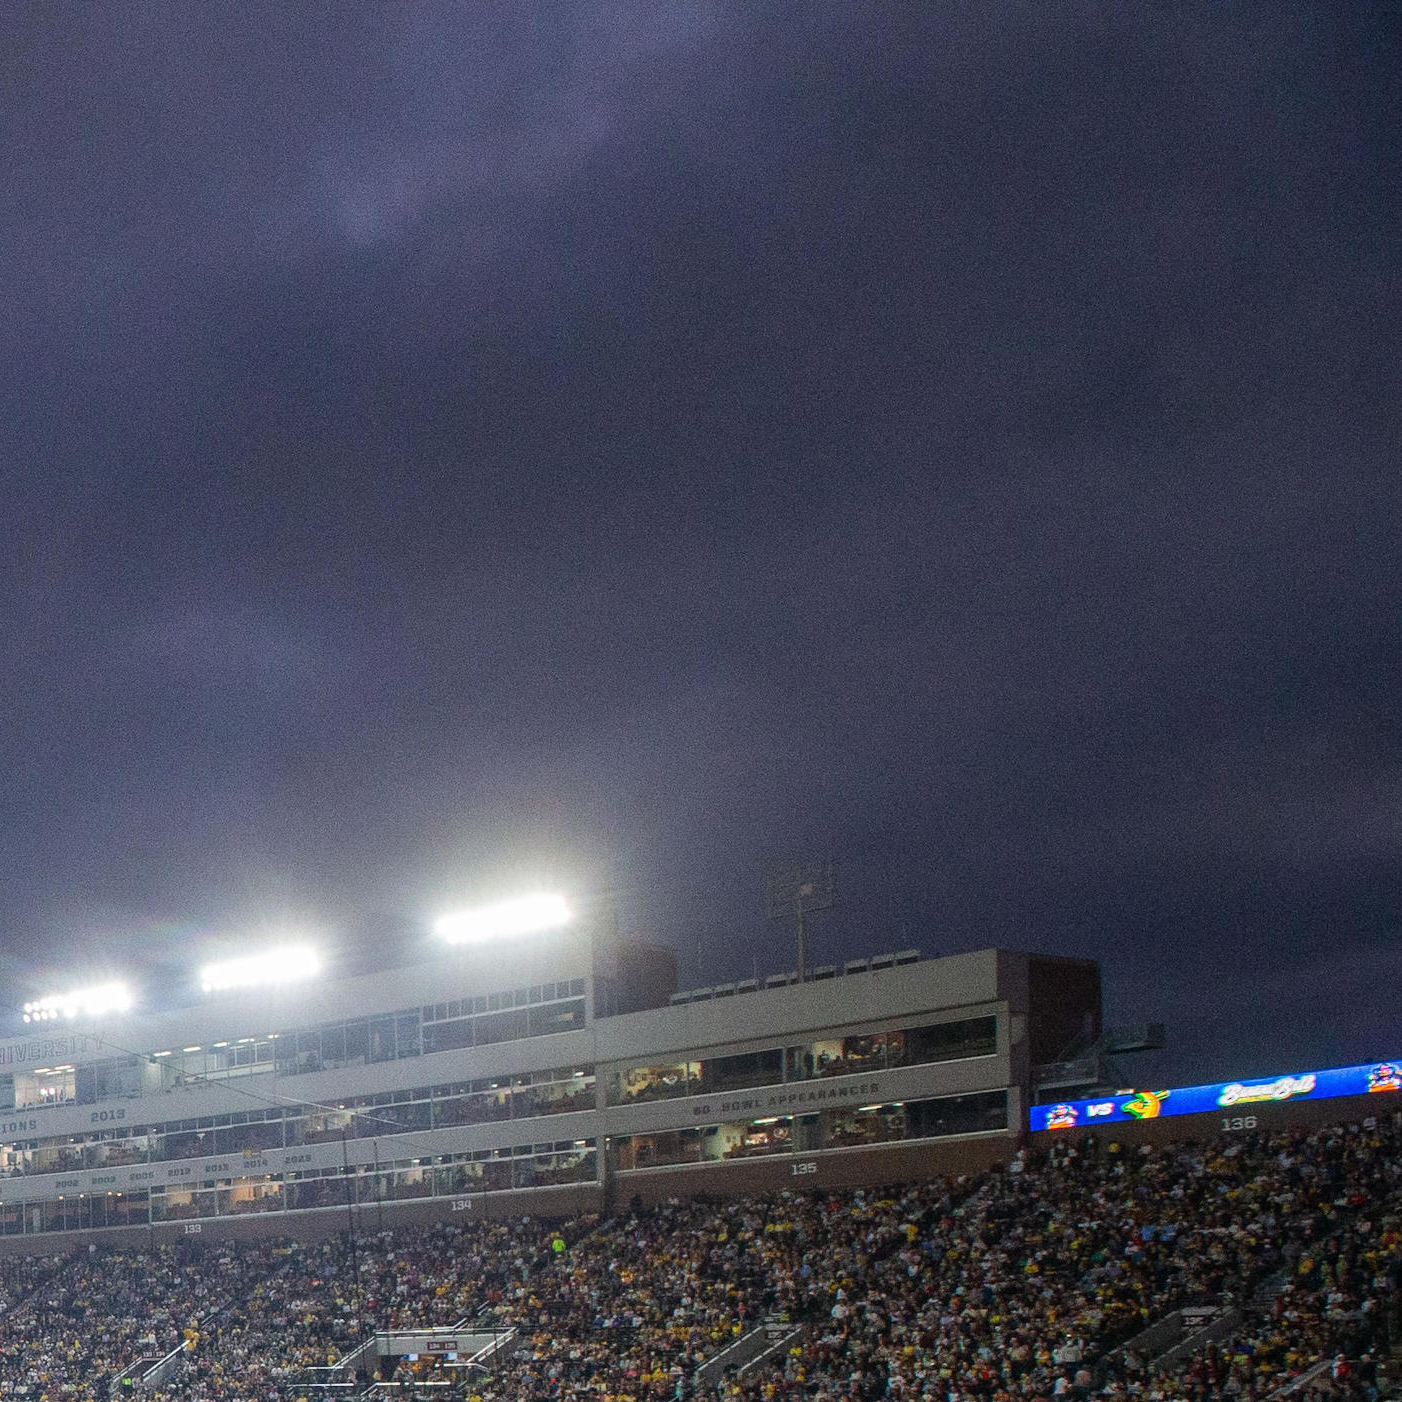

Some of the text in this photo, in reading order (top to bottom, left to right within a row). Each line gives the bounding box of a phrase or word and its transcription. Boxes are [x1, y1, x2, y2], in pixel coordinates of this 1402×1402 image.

[722, 1099, 763, 1112] BOWL
[768, 1083, 880, 1106] APPEARANCES
[1086, 1103, 1114, 1117] VS
[1221, 1115, 1258, 1131] 136
[791, 1162, 818, 1176] 135
[451, 1200, 472, 1211] 134
[184, 1224, 202, 1234] 133
